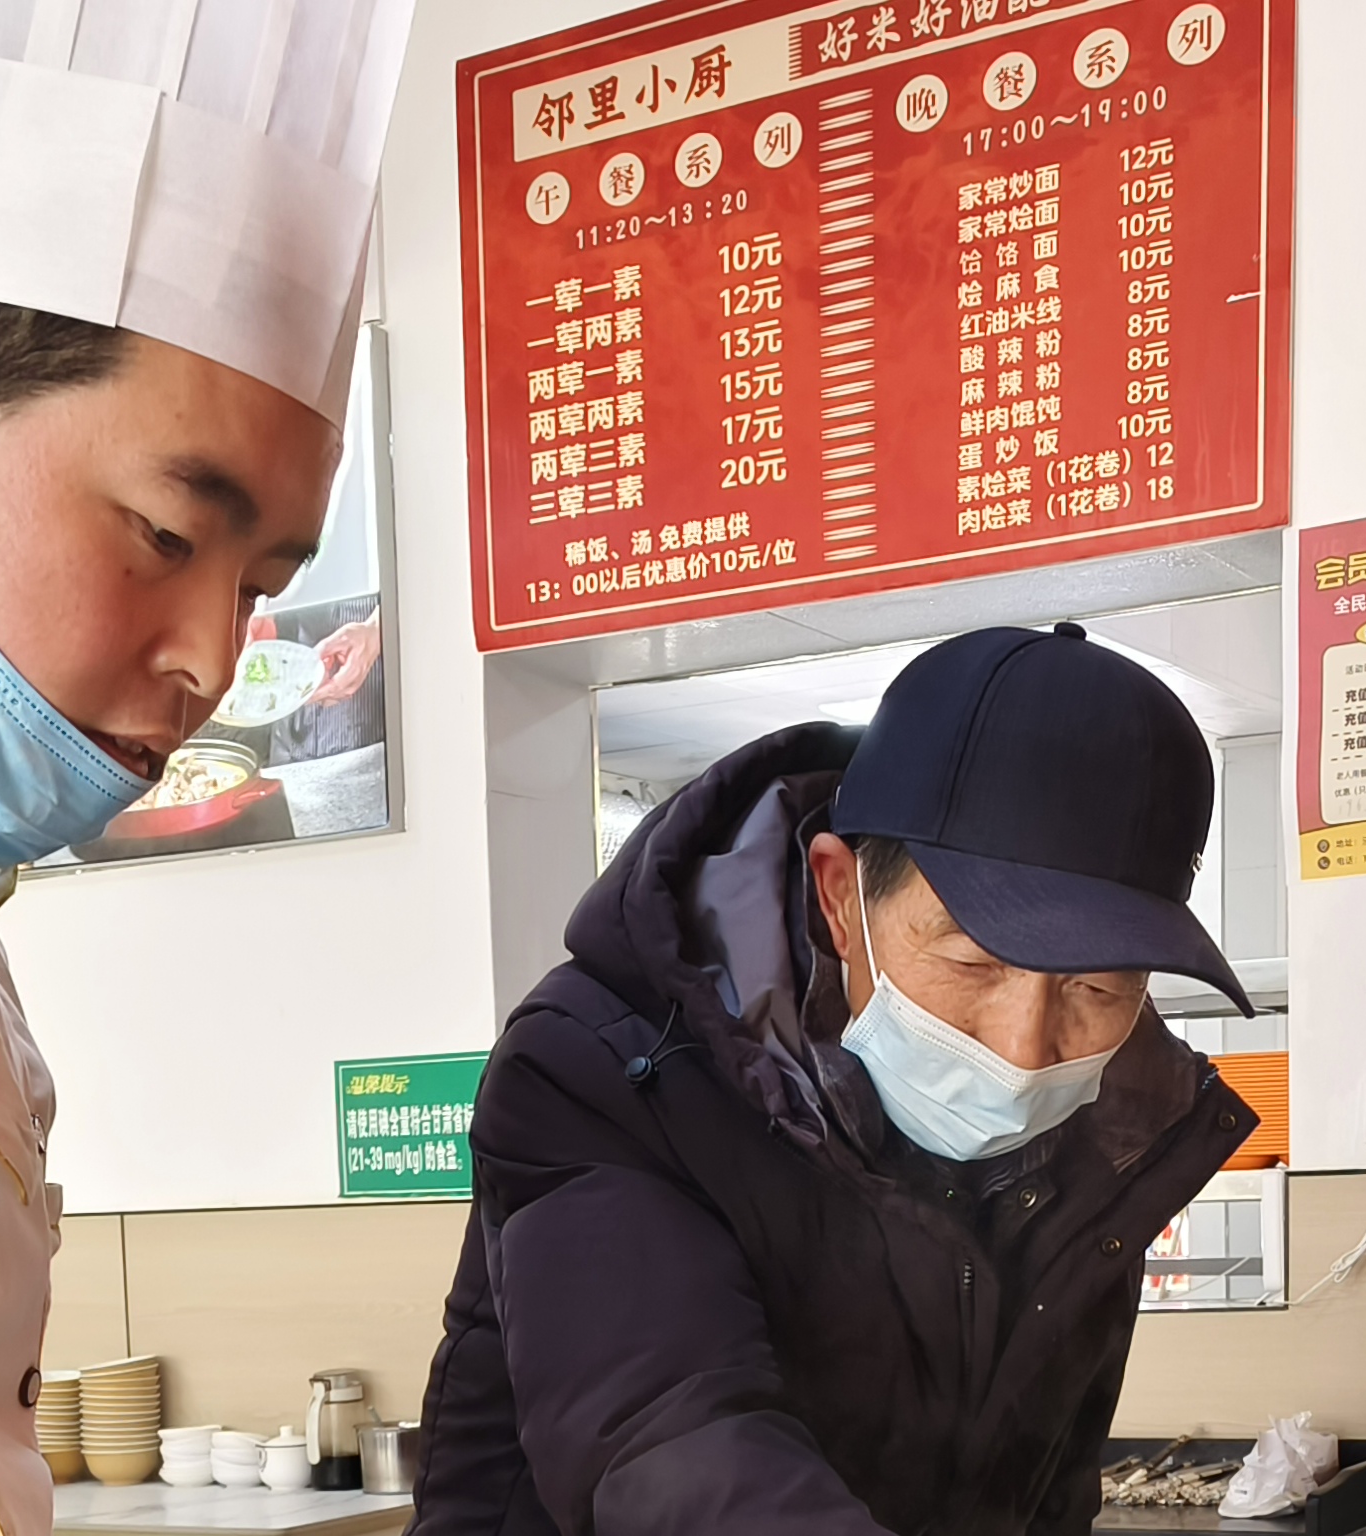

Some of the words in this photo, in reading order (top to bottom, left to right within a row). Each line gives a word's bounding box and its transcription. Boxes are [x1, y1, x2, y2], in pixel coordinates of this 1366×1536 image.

[532, 44, 732, 141] 邻里小厨
[906, 15, 1212, 124] 晚餐系列
[535, 122, 793, 216] 午餐系列
[958, 163, 1060, 211] 家常炒面
[1120, 137, 1174, 172] 12元
[958, 196, 1060, 244] 家常烩面
[1119, 171, 1174, 206] 10元
[1117, 205, 1172, 240] 10元
[526, 265, 642, 312] 一荤一素
[719, 232, 782, 274] 10元
[1118, 239, 1173, 272] 10元
[527, 307, 643, 354] 一荤两素
[720, 276, 782, 317] 12元
[959, 296, 1062, 340] 红油米线
[1127, 273, 1171, 304] 8元
[1127, 307, 1170, 338] 8元
[528, 349, 644, 404] 两荤一素
[720, 319, 783, 360] 13元
[1126, 340, 1170, 371] 8元
[529, 391, 644, 444] 两荤两素
[721, 363, 783, 403] 15元
[959, 394, 1062, 438] 鲜肉馄饨
[1126, 374, 1170, 405] 8元
[1117, 407, 1172, 440] 10元
[531, 432, 646, 485] 两荤三素
[722, 406, 783, 445] 17元
[529, 474, 644, 525] 三荤三素
[721, 448, 787, 489] 20元
[659, 512, 750, 552] 免费提供
